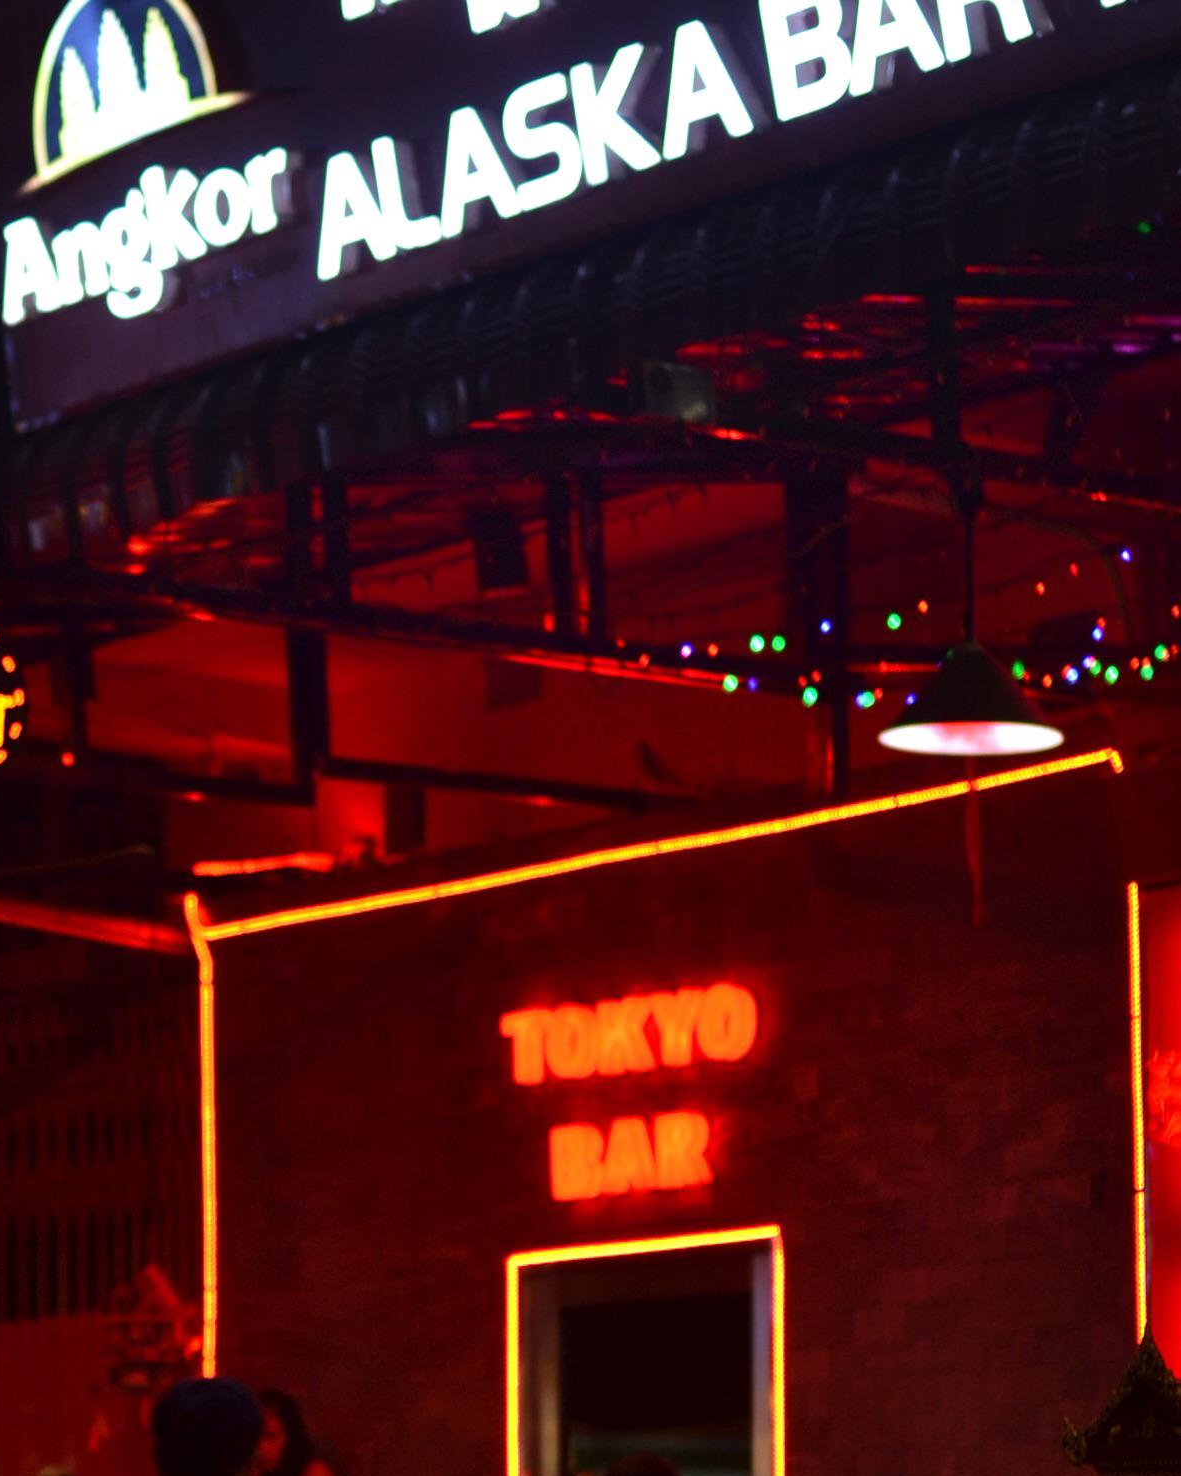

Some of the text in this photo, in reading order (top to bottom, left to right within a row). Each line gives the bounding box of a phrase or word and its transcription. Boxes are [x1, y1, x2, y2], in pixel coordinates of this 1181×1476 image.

[317, 20, 754, 281] ALASKA
[3, 148, 287, 325] Angkor
[500, 983, 758, 1085] TOKYO
[549, 1112, 713, 1201] BAR
